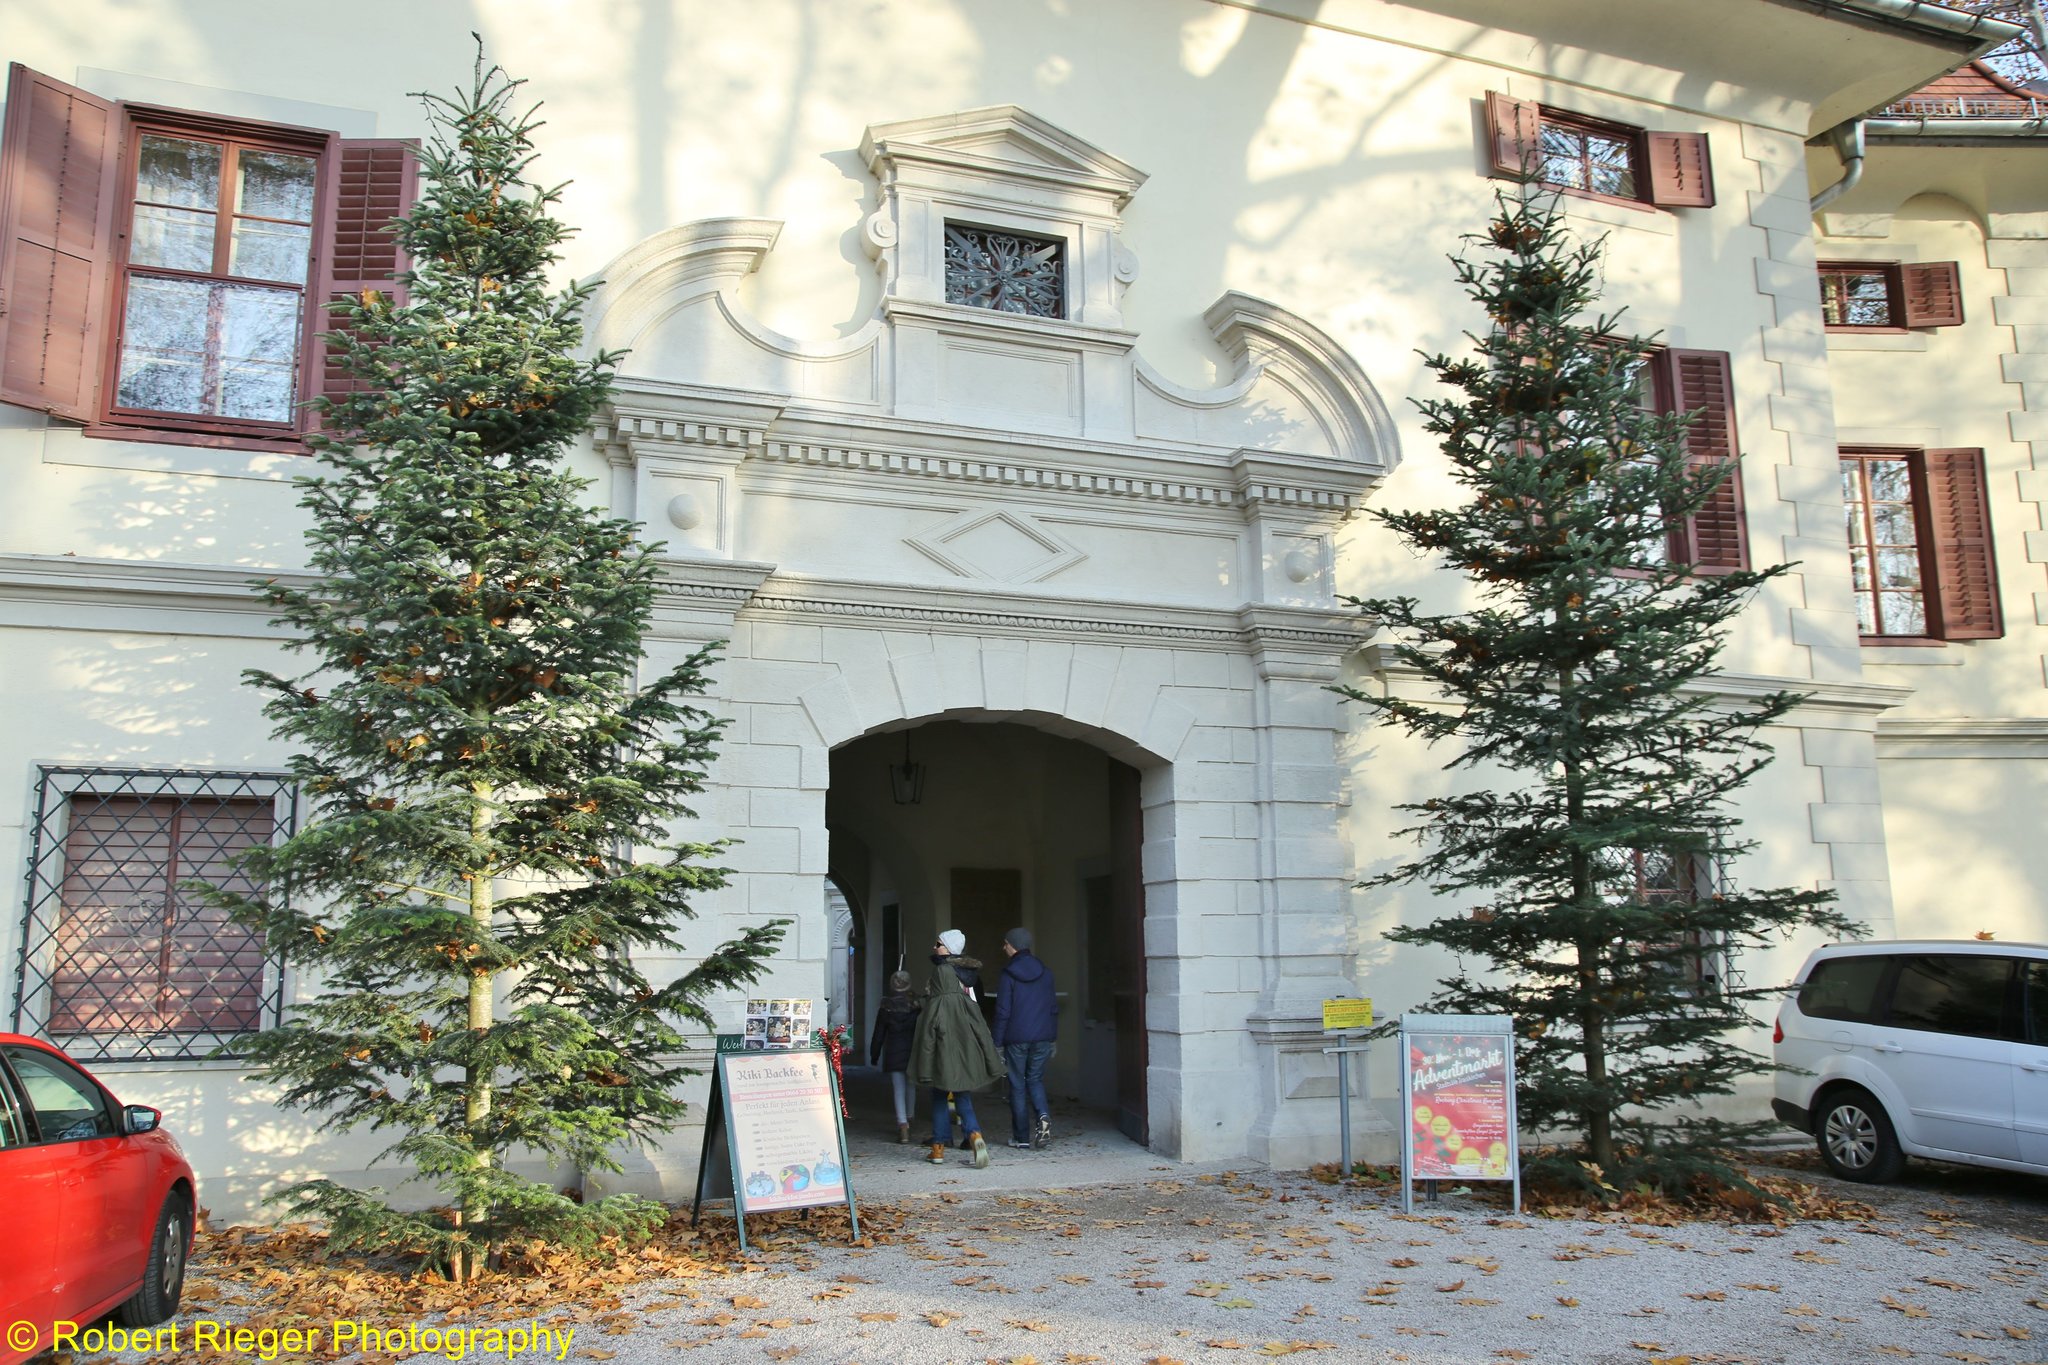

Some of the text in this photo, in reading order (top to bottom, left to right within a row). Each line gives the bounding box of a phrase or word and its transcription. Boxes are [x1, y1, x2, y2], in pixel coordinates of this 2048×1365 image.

[736, 1066, 803, 1081] Kiki Backfee
[1413, 1049, 1503, 1091] Adventmarkt
